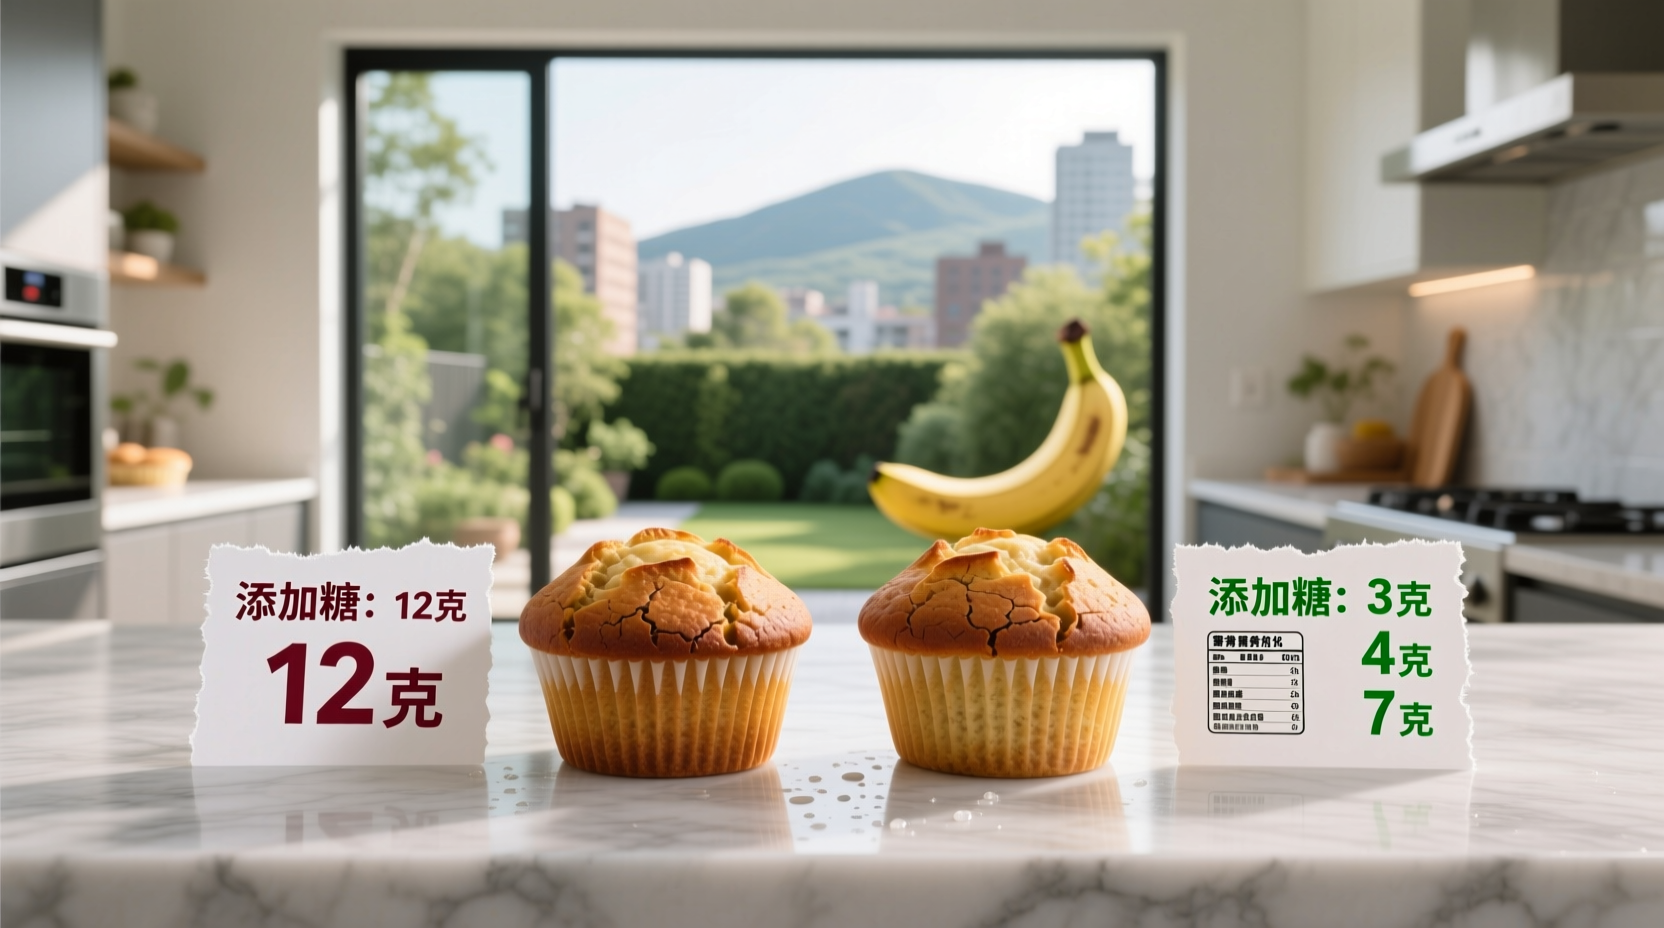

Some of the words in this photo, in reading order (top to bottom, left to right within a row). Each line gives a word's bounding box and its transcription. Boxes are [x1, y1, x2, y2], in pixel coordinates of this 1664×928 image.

[1361, 630, 1433, 679] 4克
[266, 640, 443, 729] 12克
[1363, 689, 1434, 738] 7克
